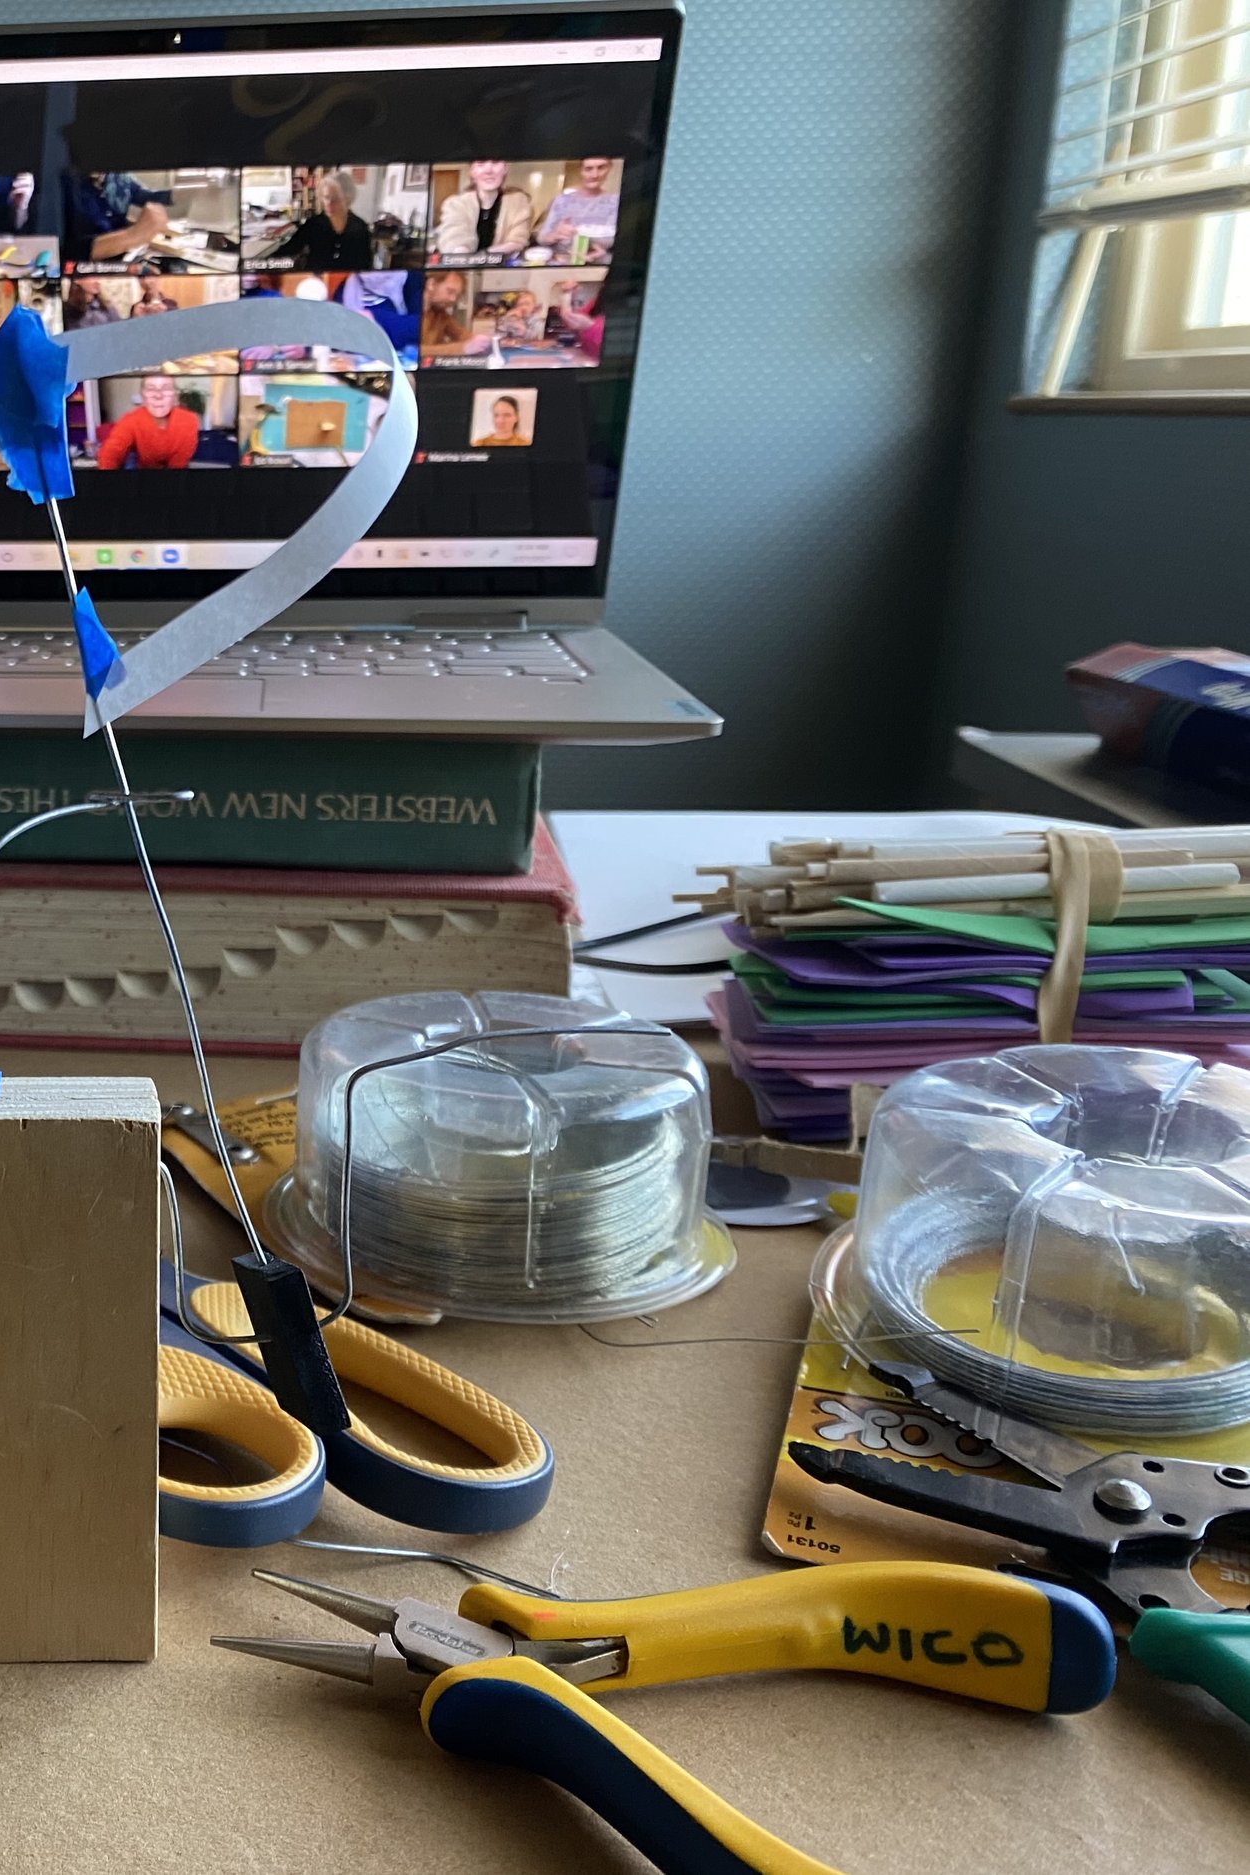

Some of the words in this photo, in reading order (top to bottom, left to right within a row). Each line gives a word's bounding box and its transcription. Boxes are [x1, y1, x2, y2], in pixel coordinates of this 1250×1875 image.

[268, 257, 294, 268] Smith
[222, 791, 308, 820] NEW
[315, 793, 497, 826] WEBSTER'S
[787, 1533, 841, 1554] 50131
[843, 1615, 1024, 1667] WICO
